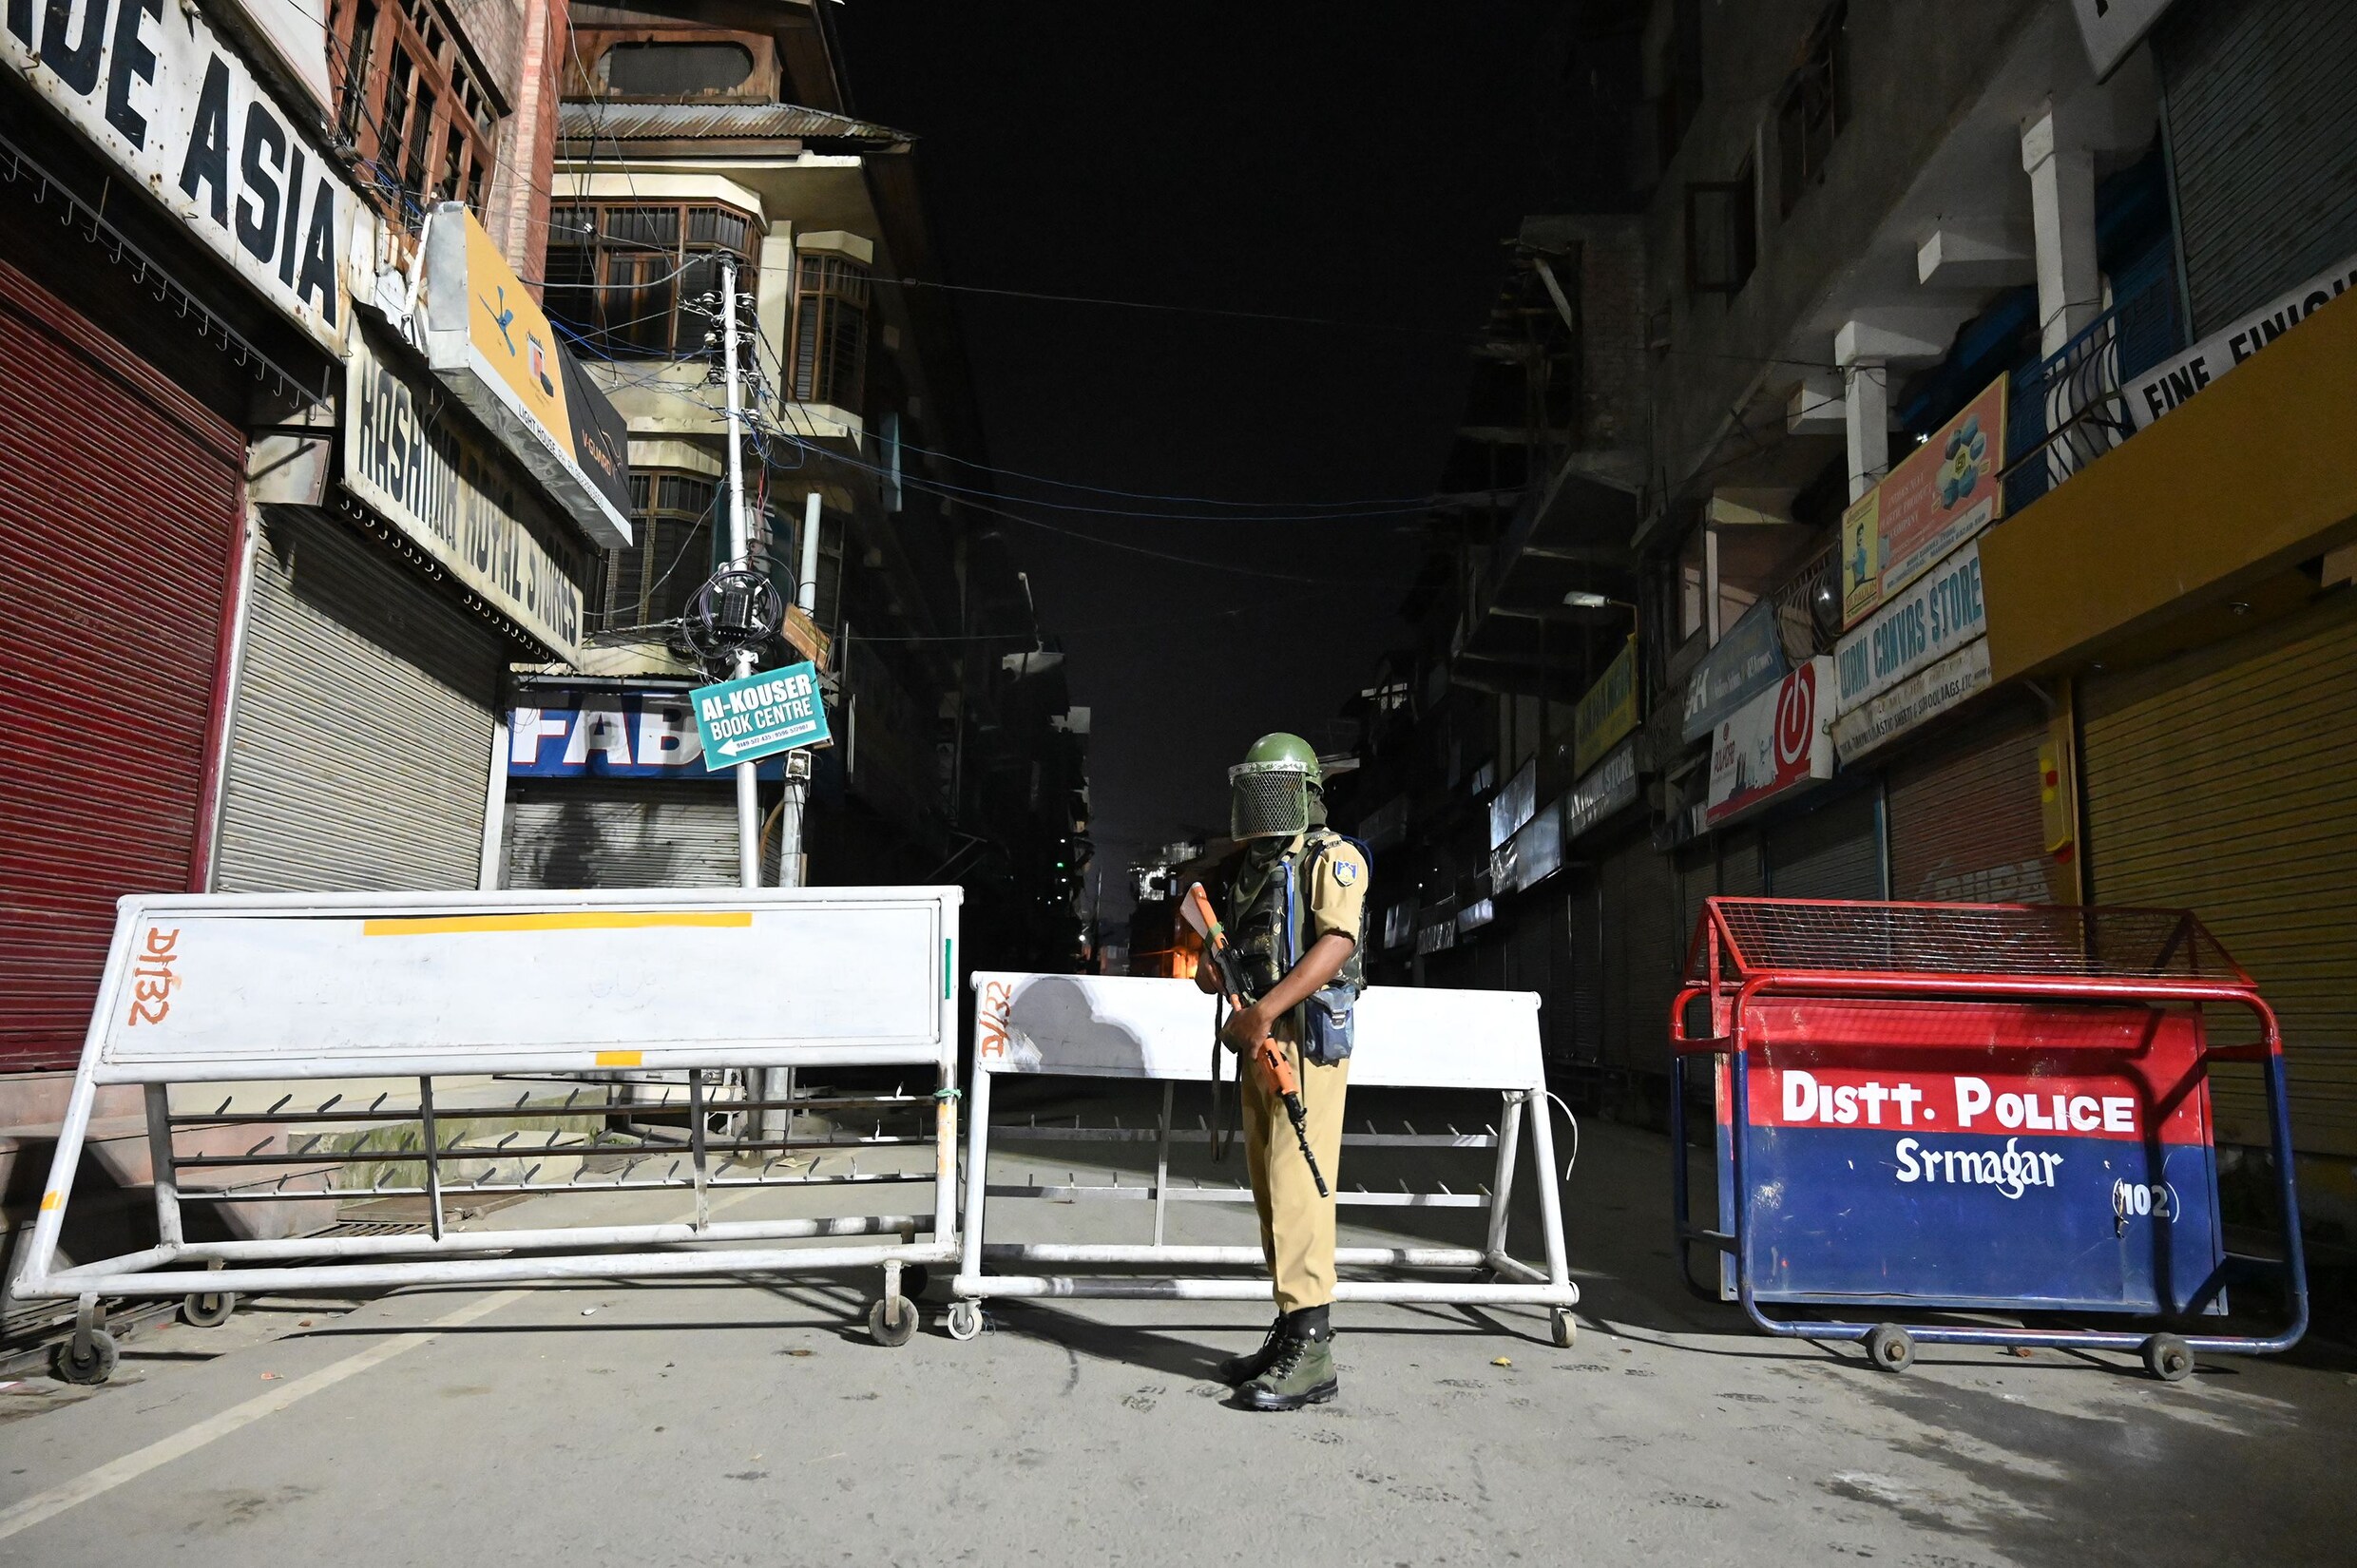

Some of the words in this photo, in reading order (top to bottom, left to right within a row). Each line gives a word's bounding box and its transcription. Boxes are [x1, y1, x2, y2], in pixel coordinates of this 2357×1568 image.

[7, 0, 166, 153] DE
[179, 50, 336, 331] ASIA
[2142, 356, 2210, 420] FINE
[518, 404, 536, 431] LIGHT
[582, 429, 612, 476] V-GUARD
[1839, 636, 1869, 700] WANI
[1873, 598, 1926, 679] CANVAS
[1929, 556, 1983, 643] STORE
[509, 691, 704, 766] FAB
[710, 713, 754, 741] BOOK
[755, 697, 814, 729] CENTRE
[1604, 743, 1634, 794] STORE
[1895, 1137, 2063, 1199] Srinagar
[2112, 1177, 2180, 1224] (102)
